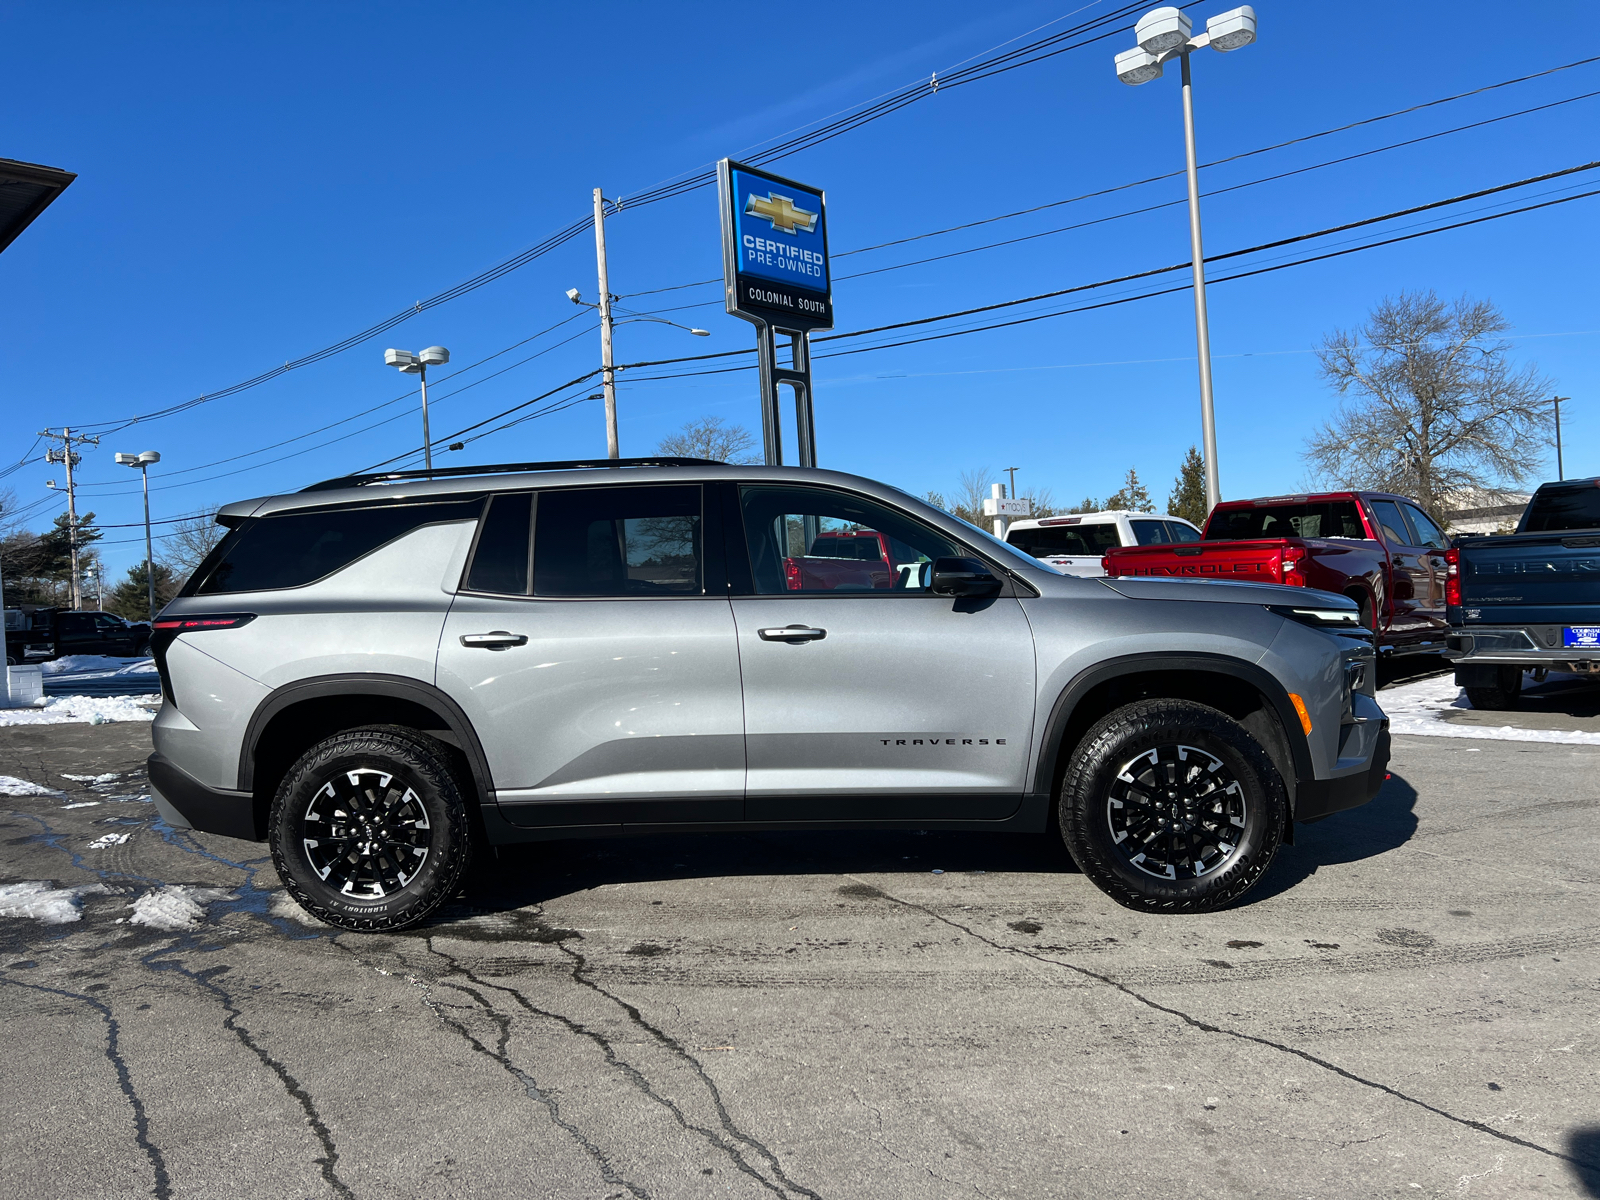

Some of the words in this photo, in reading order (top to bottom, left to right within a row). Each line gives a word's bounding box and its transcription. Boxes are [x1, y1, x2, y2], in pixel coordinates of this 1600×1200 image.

[743, 234, 824, 266] CERTIFIED
[748, 249, 821, 278] PRE-OWNED
[749, 287, 794, 308] COLONIAL
[798, 297, 826, 314] SOUTH
[1119, 562, 1267, 576] CHEVROLET
[880, 738, 1007, 746] TRAVERSE
[342, 905, 389, 914] TERRITORY
